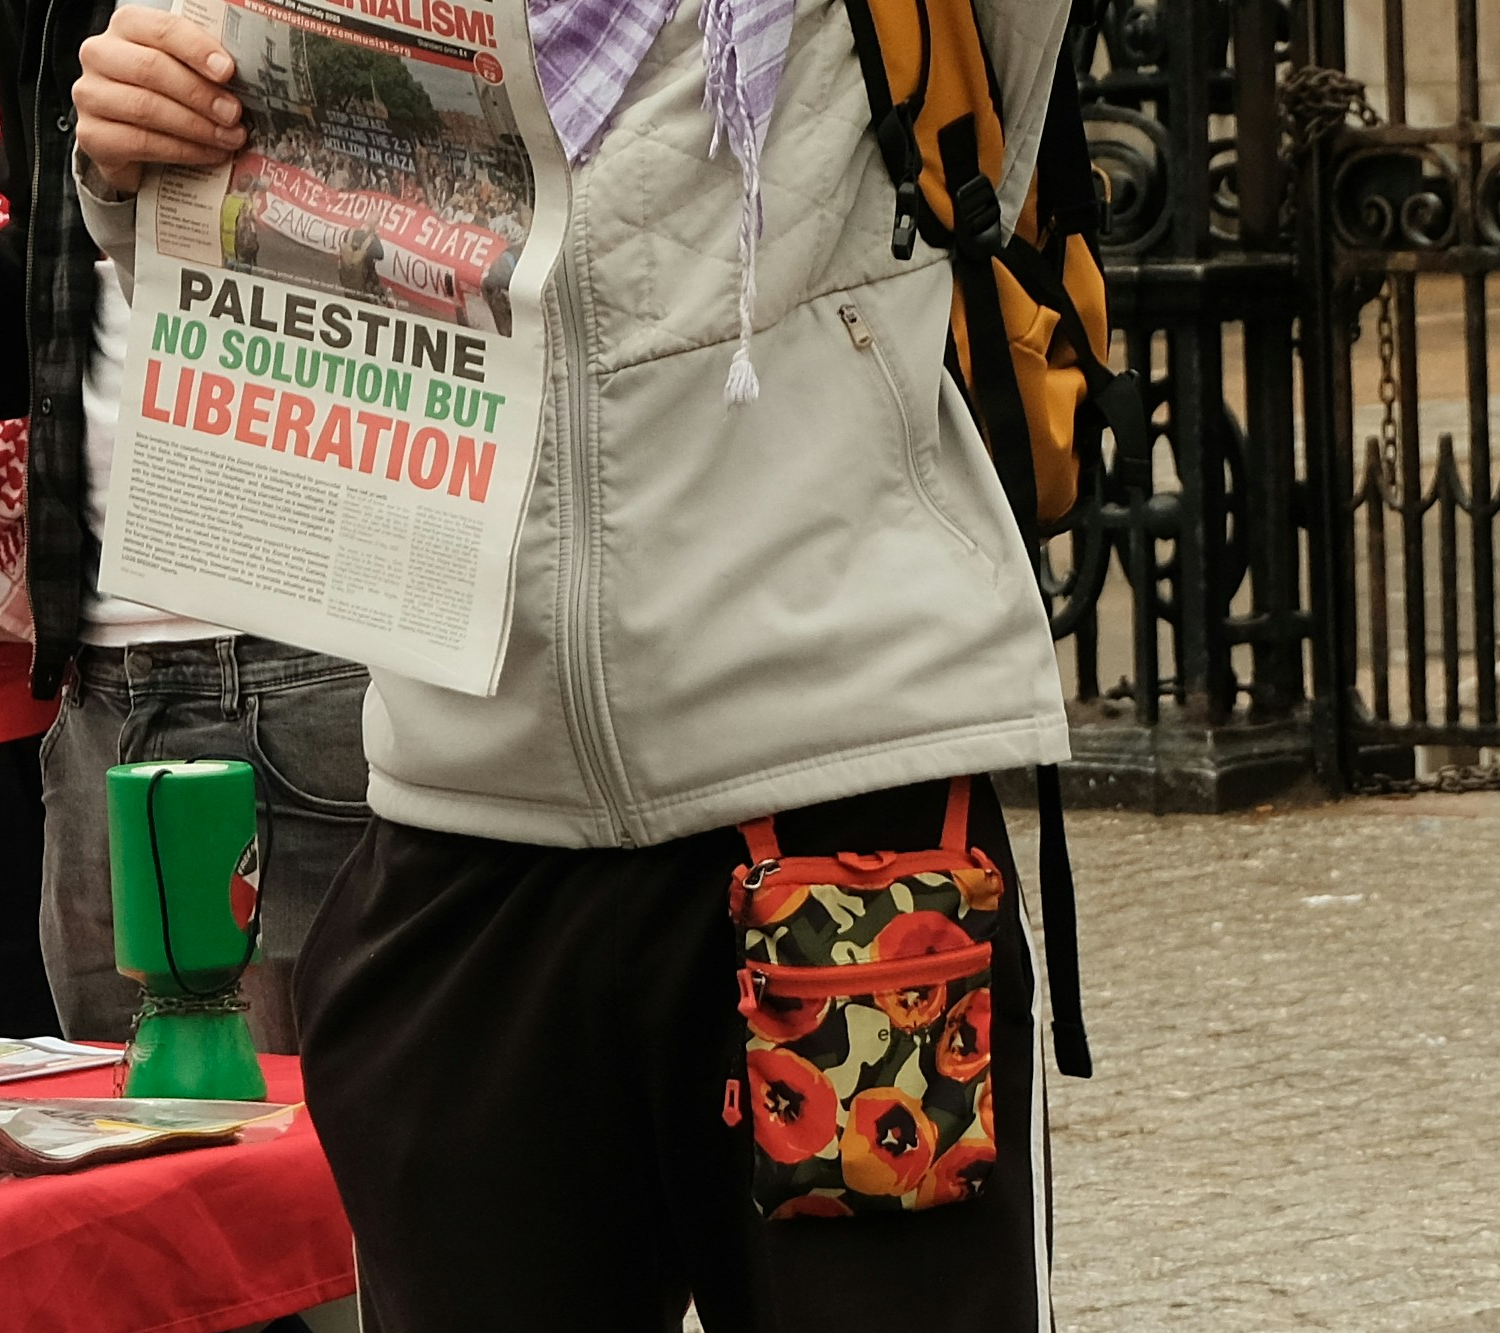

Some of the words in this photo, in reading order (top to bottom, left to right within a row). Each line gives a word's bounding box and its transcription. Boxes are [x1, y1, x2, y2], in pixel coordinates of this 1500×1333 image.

[385, 152, 416, 174] GAZA
[415, 215, 494, 267] STATE
[152, 312, 207, 360] NO
[218, 328, 412, 413] SOLUTION
[424, 378, 506, 433] BUT
[179, 267, 486, 383] PALESTINE
[141, 358, 497, 503] LIBERATION
